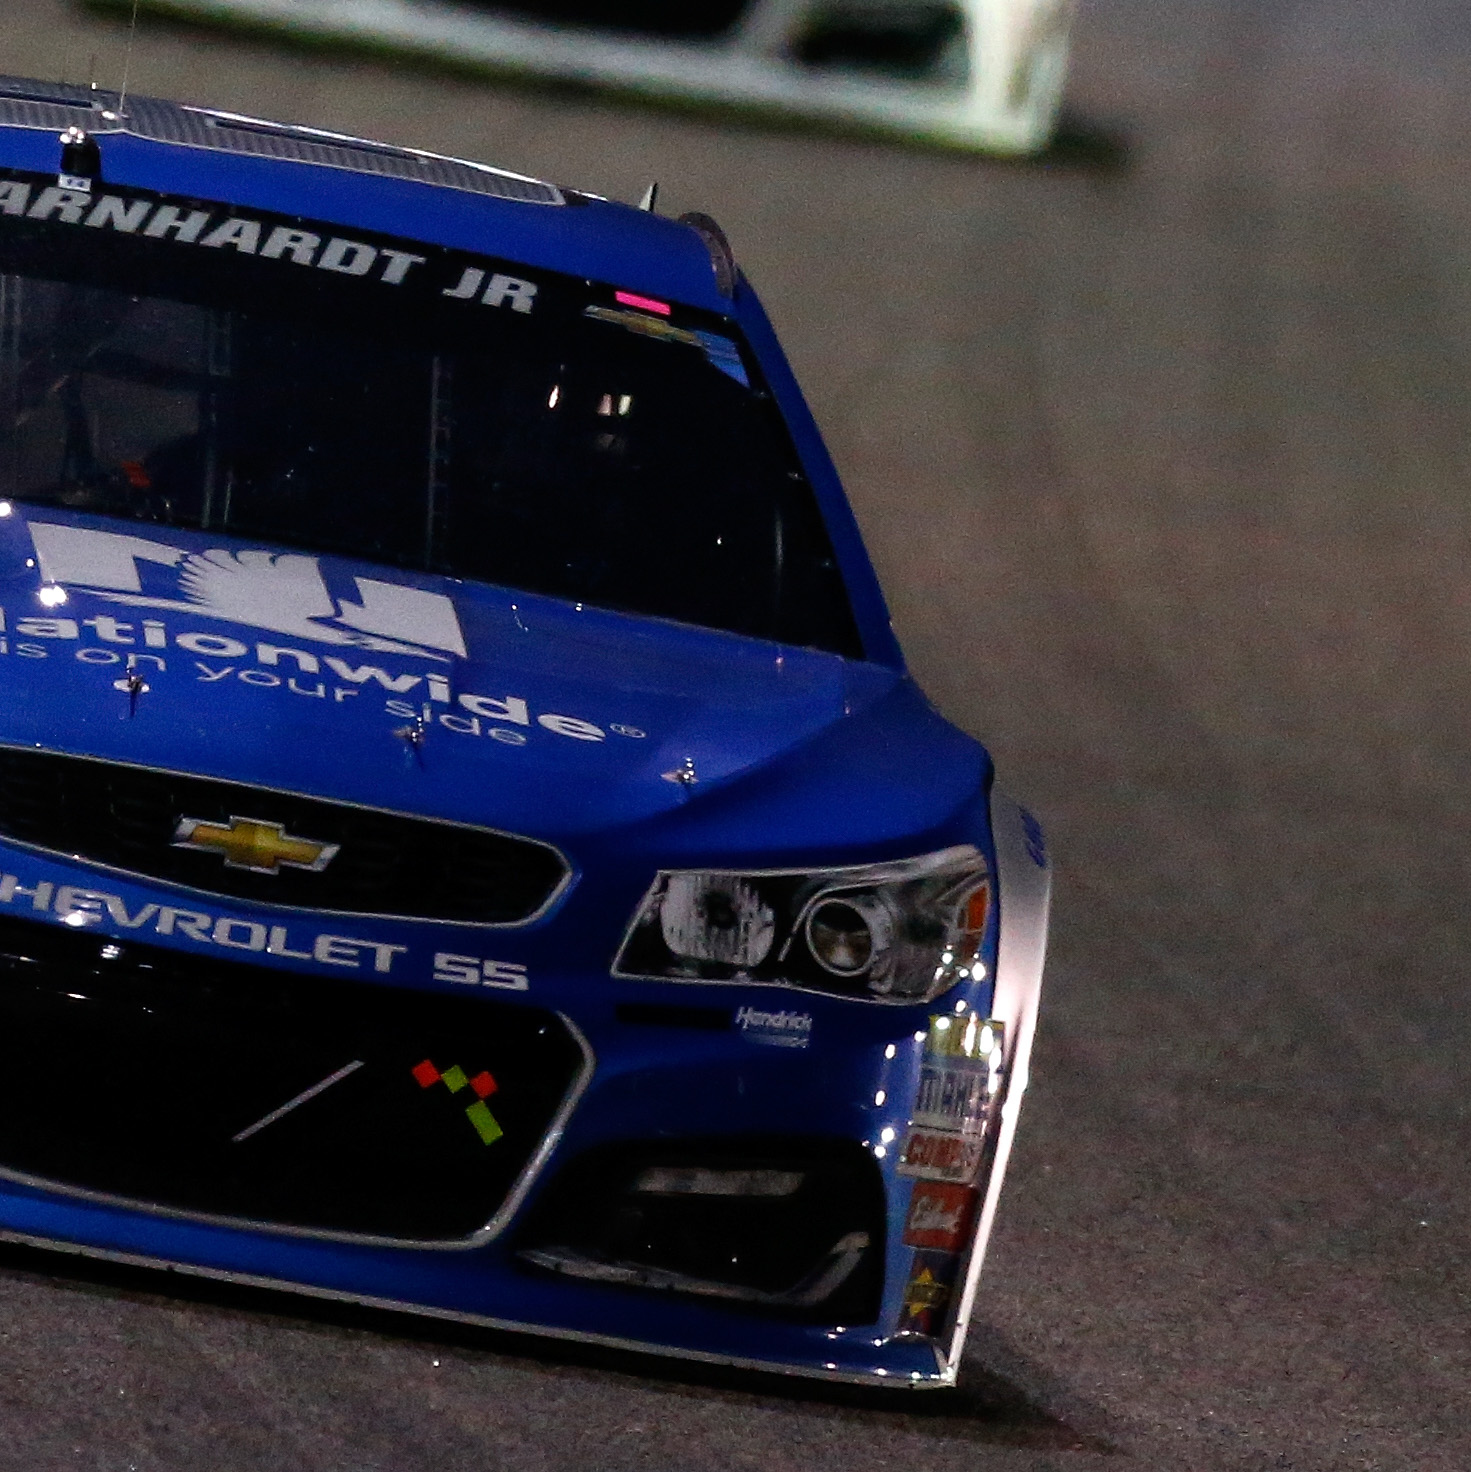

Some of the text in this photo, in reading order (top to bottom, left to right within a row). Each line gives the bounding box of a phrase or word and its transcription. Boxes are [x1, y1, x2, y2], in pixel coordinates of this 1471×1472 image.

[443, 267, 539, 313] JR
[0, 636, 527, 746] is on your side
[433, 952, 529, 991] SS
[734, 1005, 813, 1032] Hendrick
